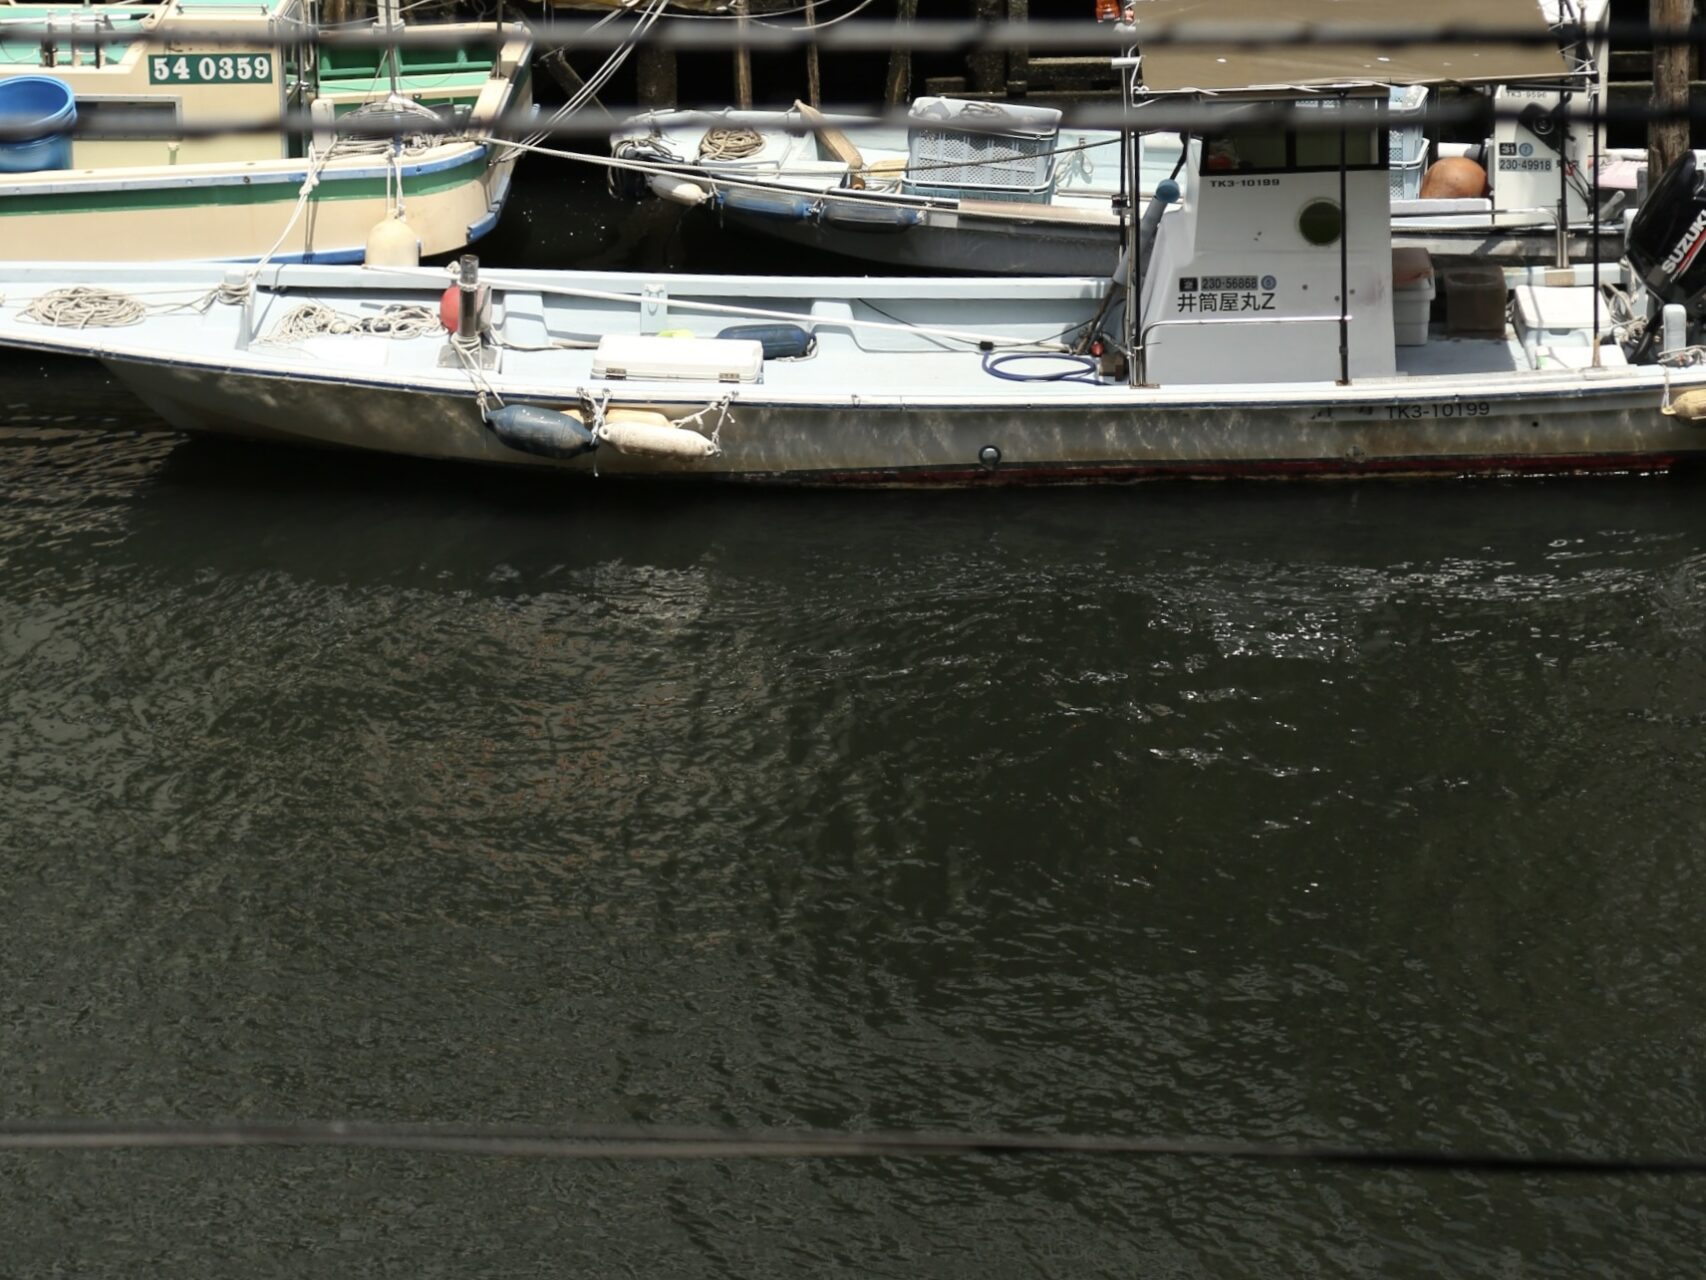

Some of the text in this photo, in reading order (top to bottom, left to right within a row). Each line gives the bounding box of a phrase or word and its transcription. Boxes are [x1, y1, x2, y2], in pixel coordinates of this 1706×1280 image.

[153, 57, 270, 80] 54 0359
[1177, 292, 1276, 313] 井筒屋丸Z
[1384, 401, 1490, 419] TK3-10199
